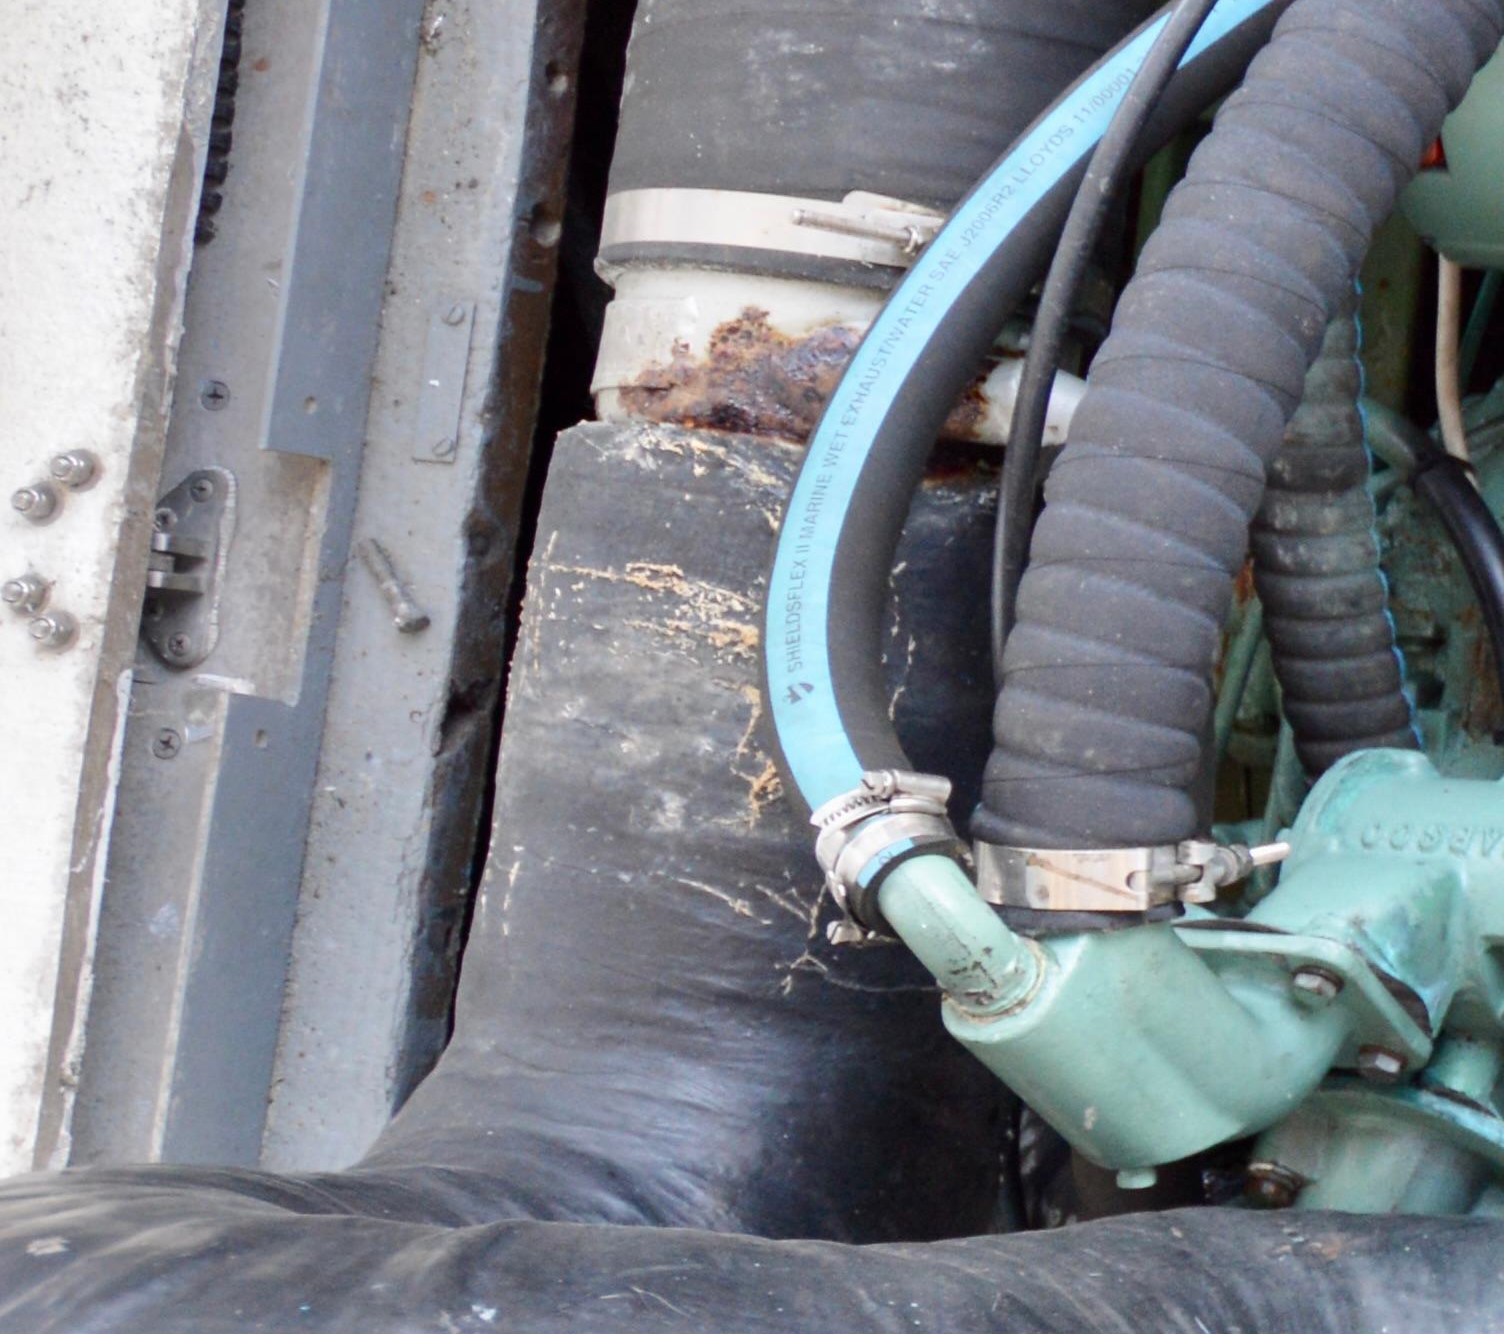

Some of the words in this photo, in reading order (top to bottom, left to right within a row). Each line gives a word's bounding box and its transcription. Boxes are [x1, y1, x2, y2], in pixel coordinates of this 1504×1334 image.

[787, 558, 809, 673] SHIELDSFLEX
[798, 472, 834, 544] MARINE
[821, 432, 849, 473] WET
[928, 249, 962, 283] SAE
[1013, 123, 1075, 187] LLOYDS
